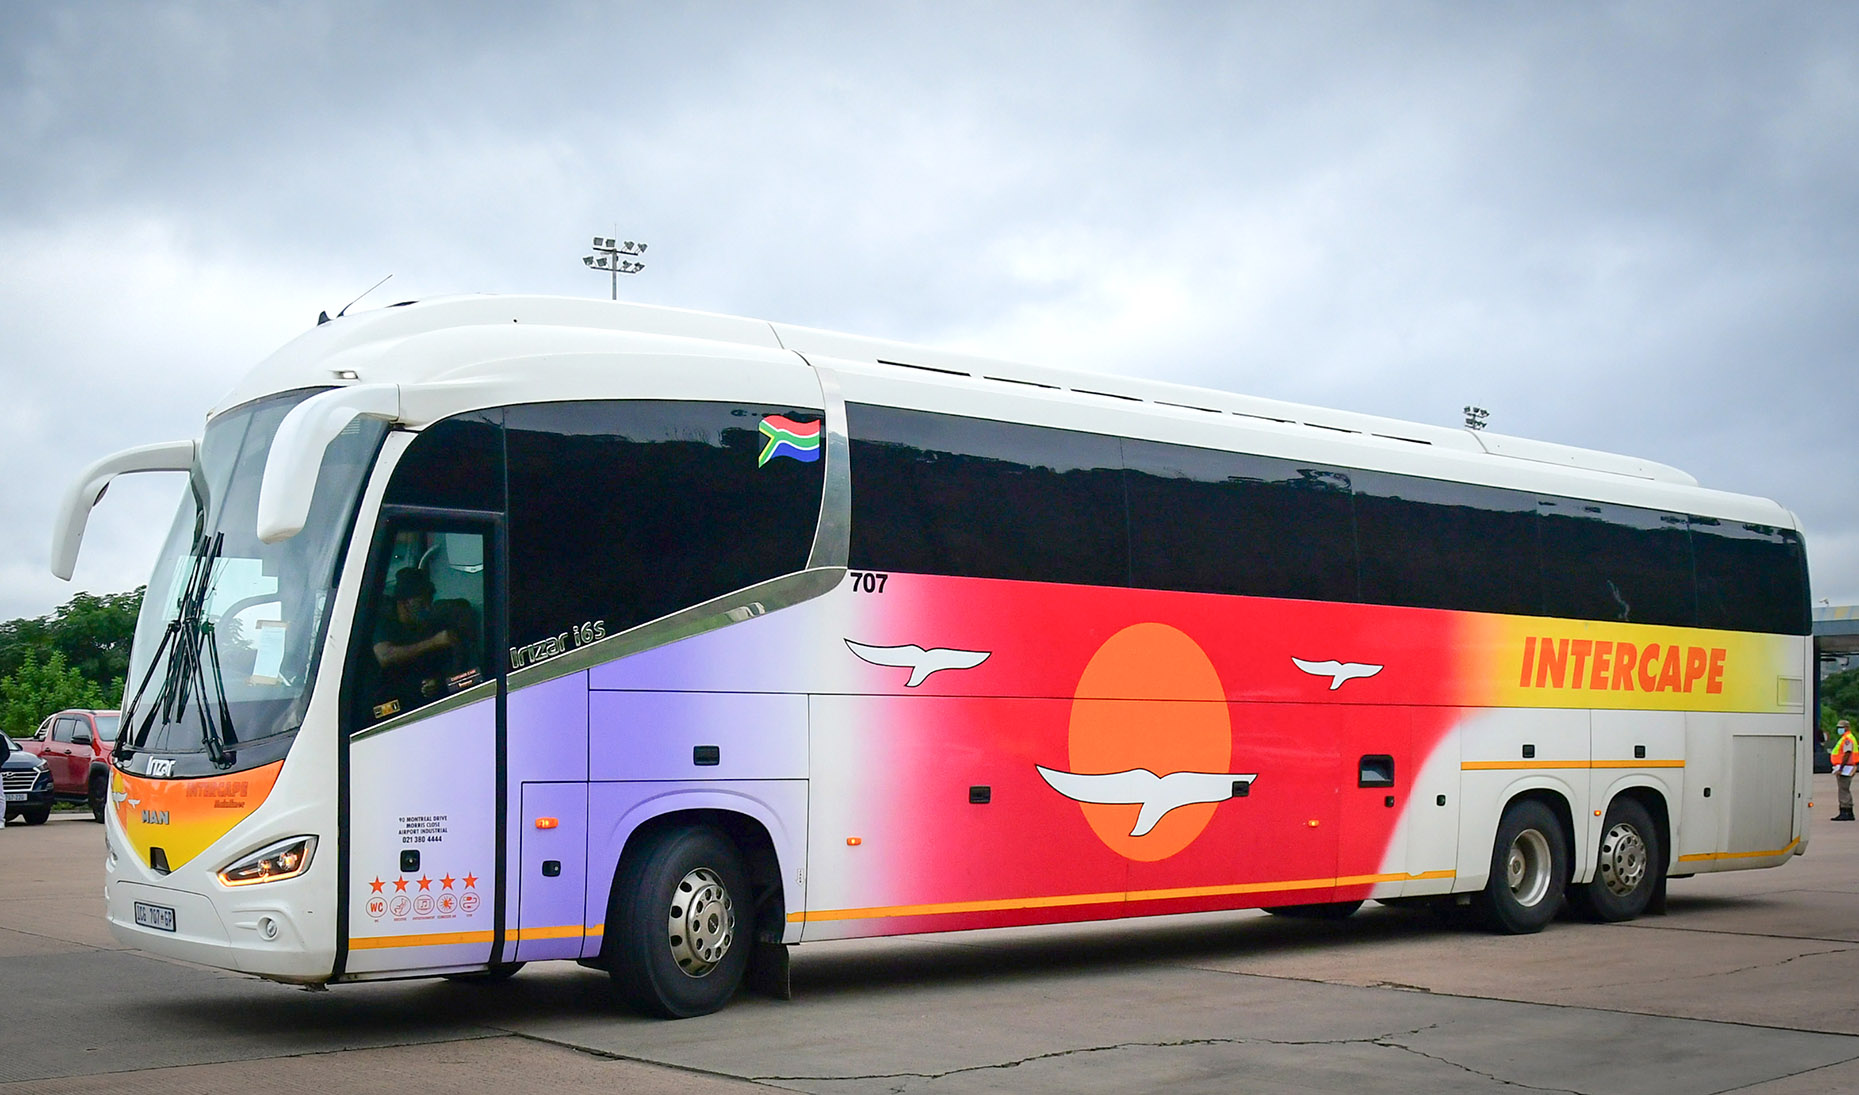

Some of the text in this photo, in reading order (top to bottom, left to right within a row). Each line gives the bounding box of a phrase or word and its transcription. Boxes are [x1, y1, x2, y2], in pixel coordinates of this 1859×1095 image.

[850, 572, 888, 593] 707
[509, 620, 606, 669] Irizar i6s
[1519, 636, 1727, 694] INTERCAPE
[186, 781, 249, 798] INTERCAPE
[142, 809, 170, 825] MAN
[414, 835, 426, 843] 380
[370, 902, 384, 913] WC
